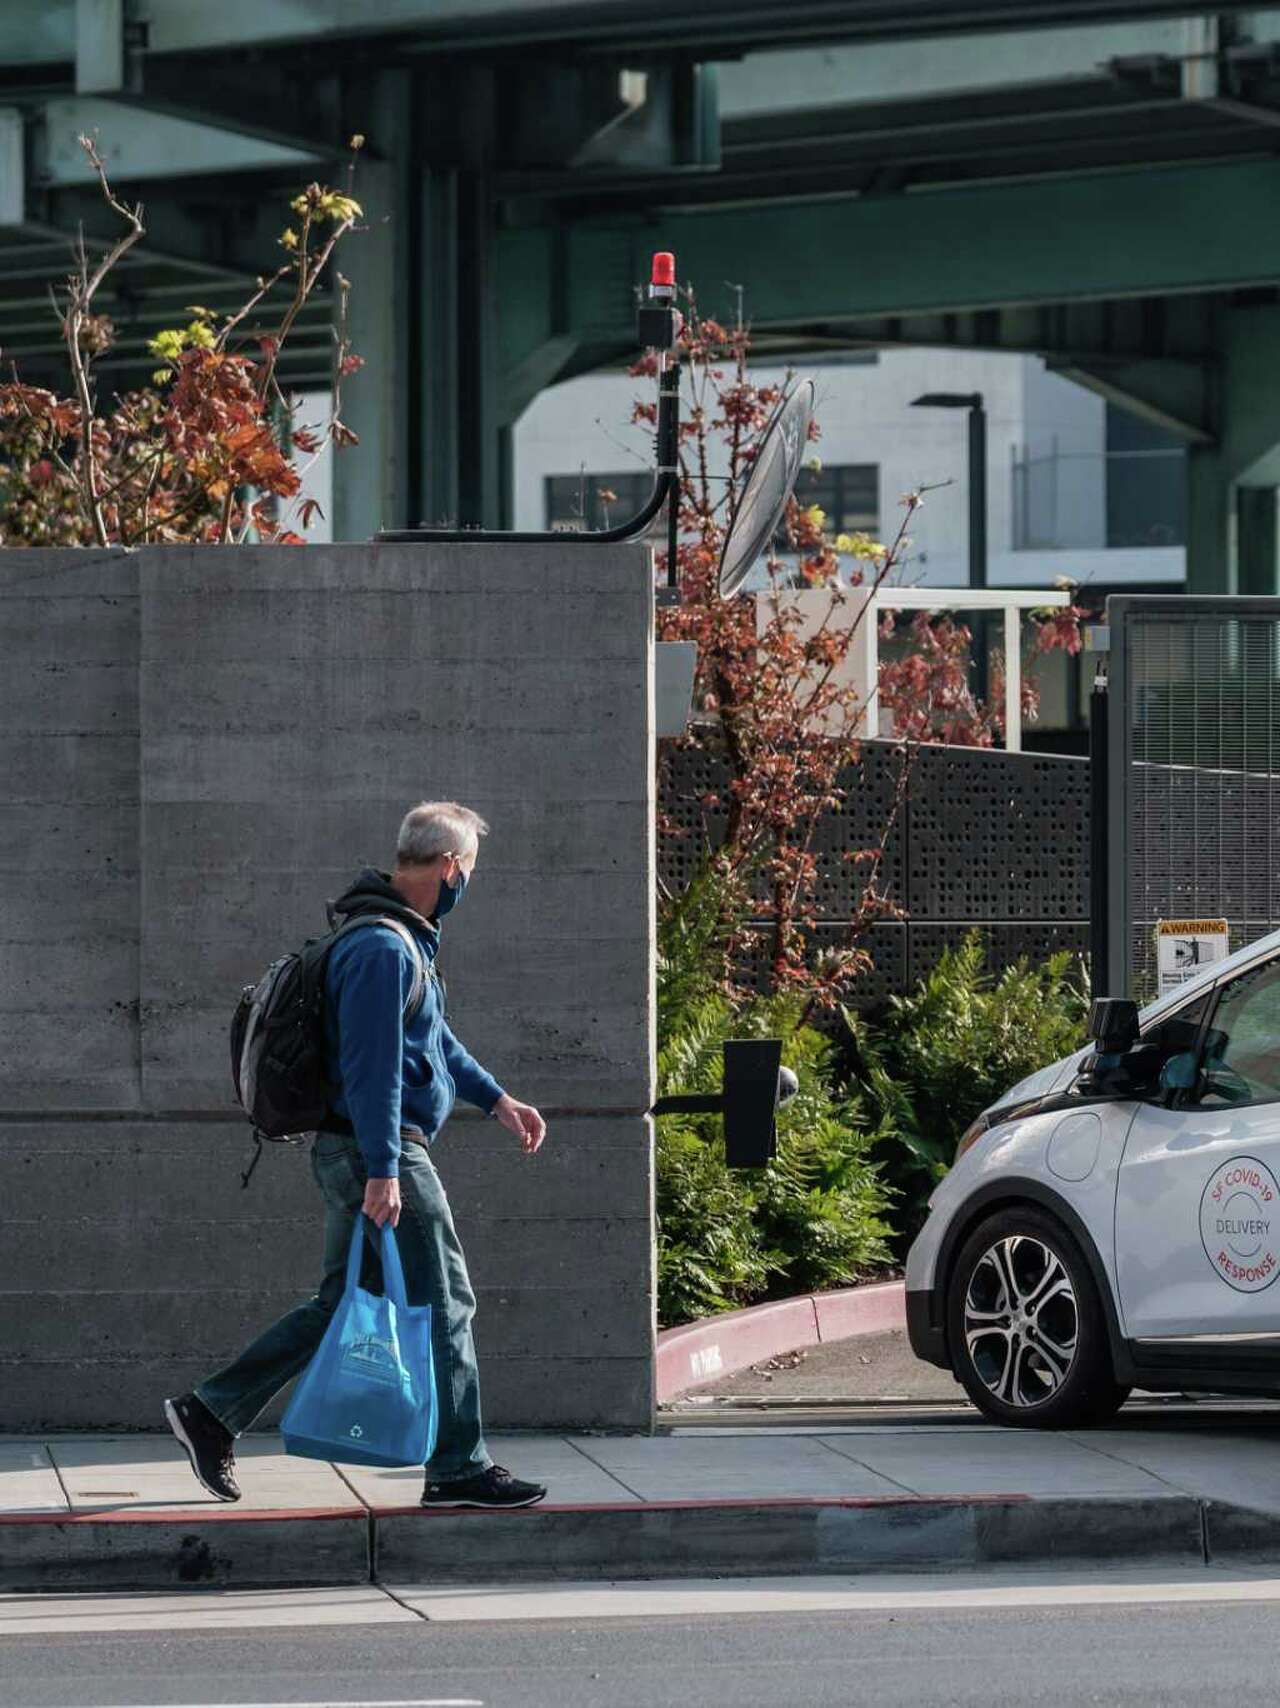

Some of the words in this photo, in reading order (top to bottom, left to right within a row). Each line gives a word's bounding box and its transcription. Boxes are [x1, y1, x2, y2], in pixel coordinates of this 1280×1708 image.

[1170, 922, 1225, 934] WARNING
[1212, 1181, 1224, 1201] SF
[1225, 1168, 1273, 1202] COVID-19
[1216, 1220, 1271, 1234] DELIVERY
[1217, 1251, 1277, 1282] RESPONSE
